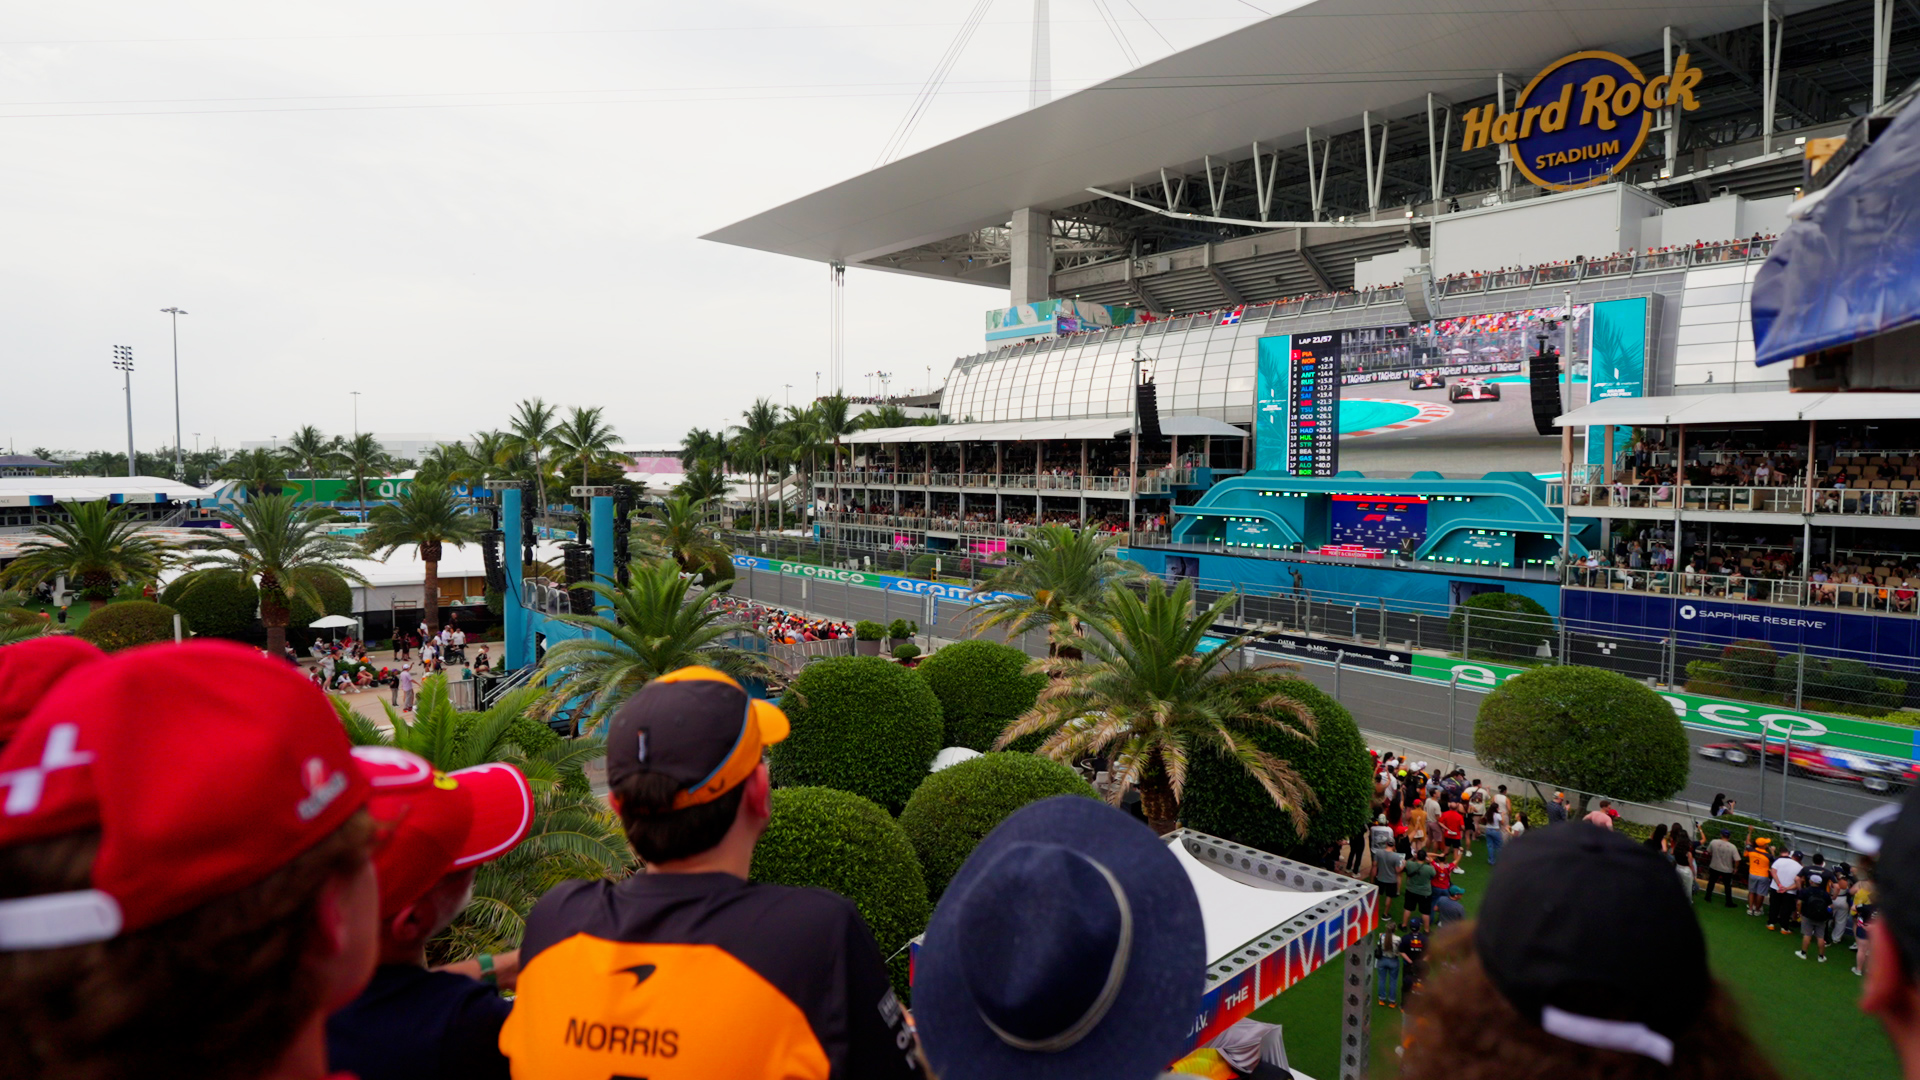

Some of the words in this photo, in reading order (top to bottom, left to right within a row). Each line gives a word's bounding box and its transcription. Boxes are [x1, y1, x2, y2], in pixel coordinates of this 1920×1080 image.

[1461, 82, 1575, 152] Hard
[1579, 53, 1703, 130] Rock
[1536, 139, 1620, 170] STADIUM
[780, 564, 864, 583] aramco
[1699, 610, 1760, 622] SAPPHIRE
[1224, 986, 1248, 1010] THE
[564, 1018, 678, 1058] NORRIS
